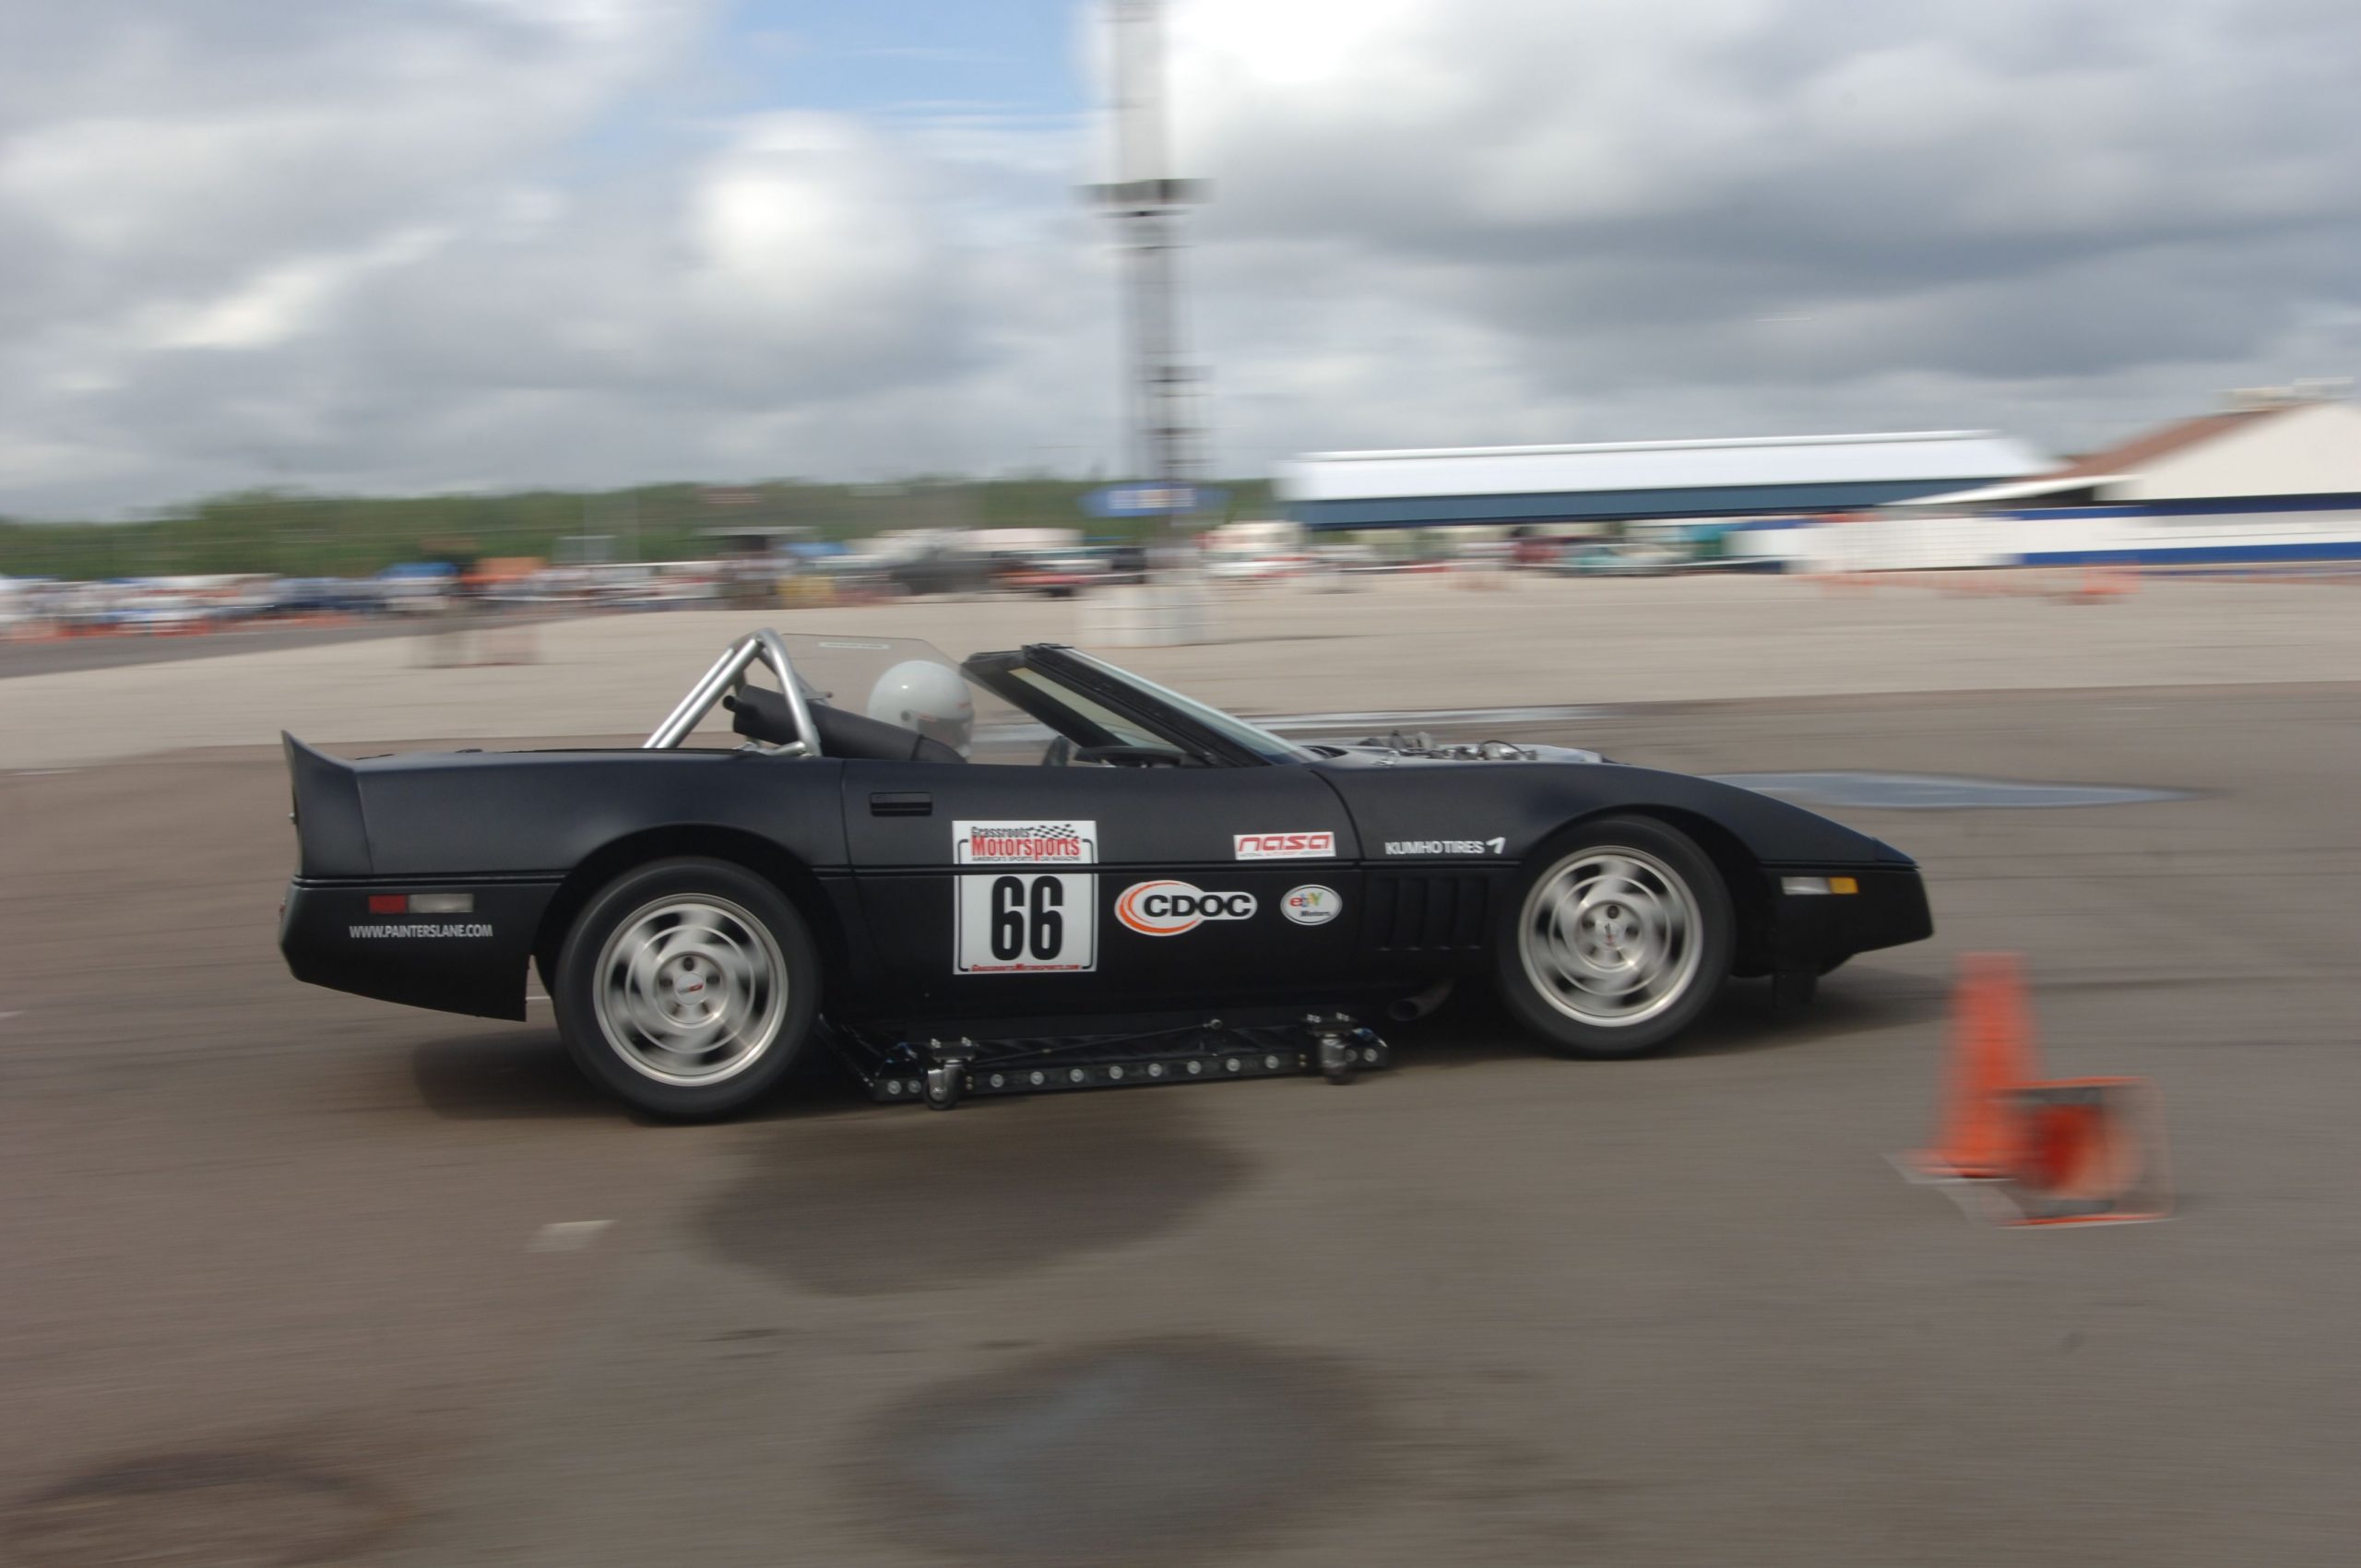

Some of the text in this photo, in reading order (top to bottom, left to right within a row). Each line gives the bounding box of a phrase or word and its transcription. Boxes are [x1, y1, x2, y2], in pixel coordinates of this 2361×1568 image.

[971, 836, 1081, 861] Motorsports
[991, 875, 1064, 960] 66
[1143, 894, 1252, 918] CDOC
[349, 924, 493, 938] WWW.PAINTERSLANE.COM
